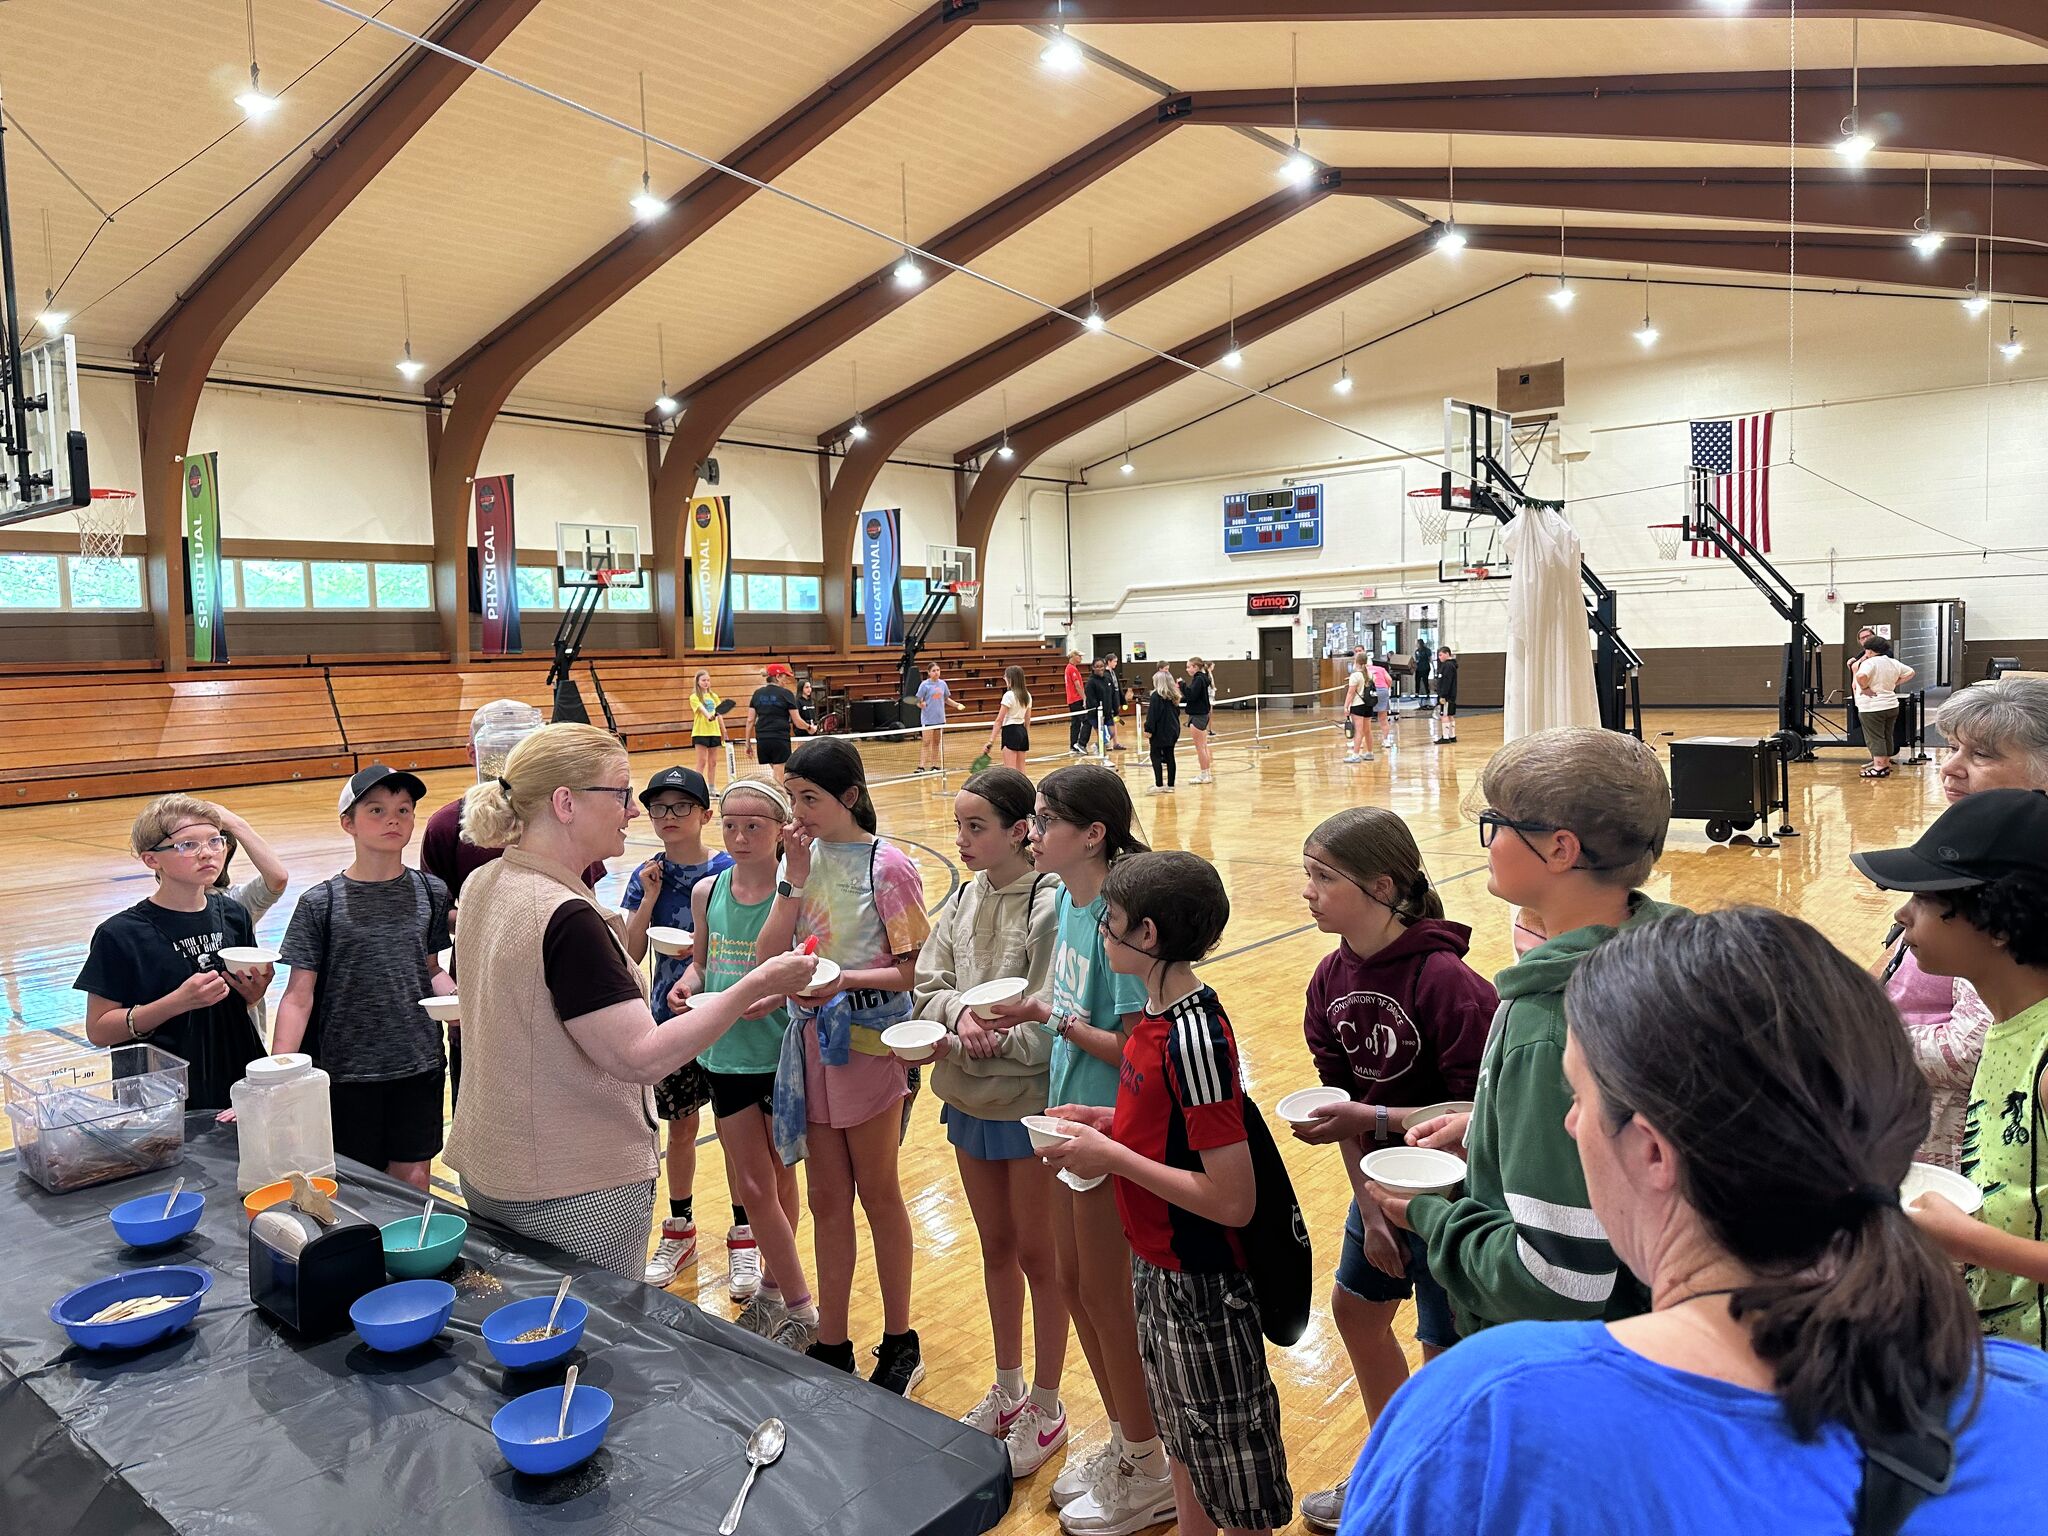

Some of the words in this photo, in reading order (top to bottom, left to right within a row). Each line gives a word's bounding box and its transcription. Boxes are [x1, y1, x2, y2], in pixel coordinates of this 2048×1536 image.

[1295, 487, 1318, 496] VISITOR
[1225, 495, 1246, 504] HOME
[1295, 511, 1311, 519] BONUS
[193, 513, 209, 629] SPIRITUAL
[484, 525, 499, 620] PHYSICAL
[700, 538, 712, 635] EMOTIONAL
[870, 541, 883, 640] EDUCATIONAL
[1252, 596, 1295, 608] armory
[198, 934, 209, 945] TO
